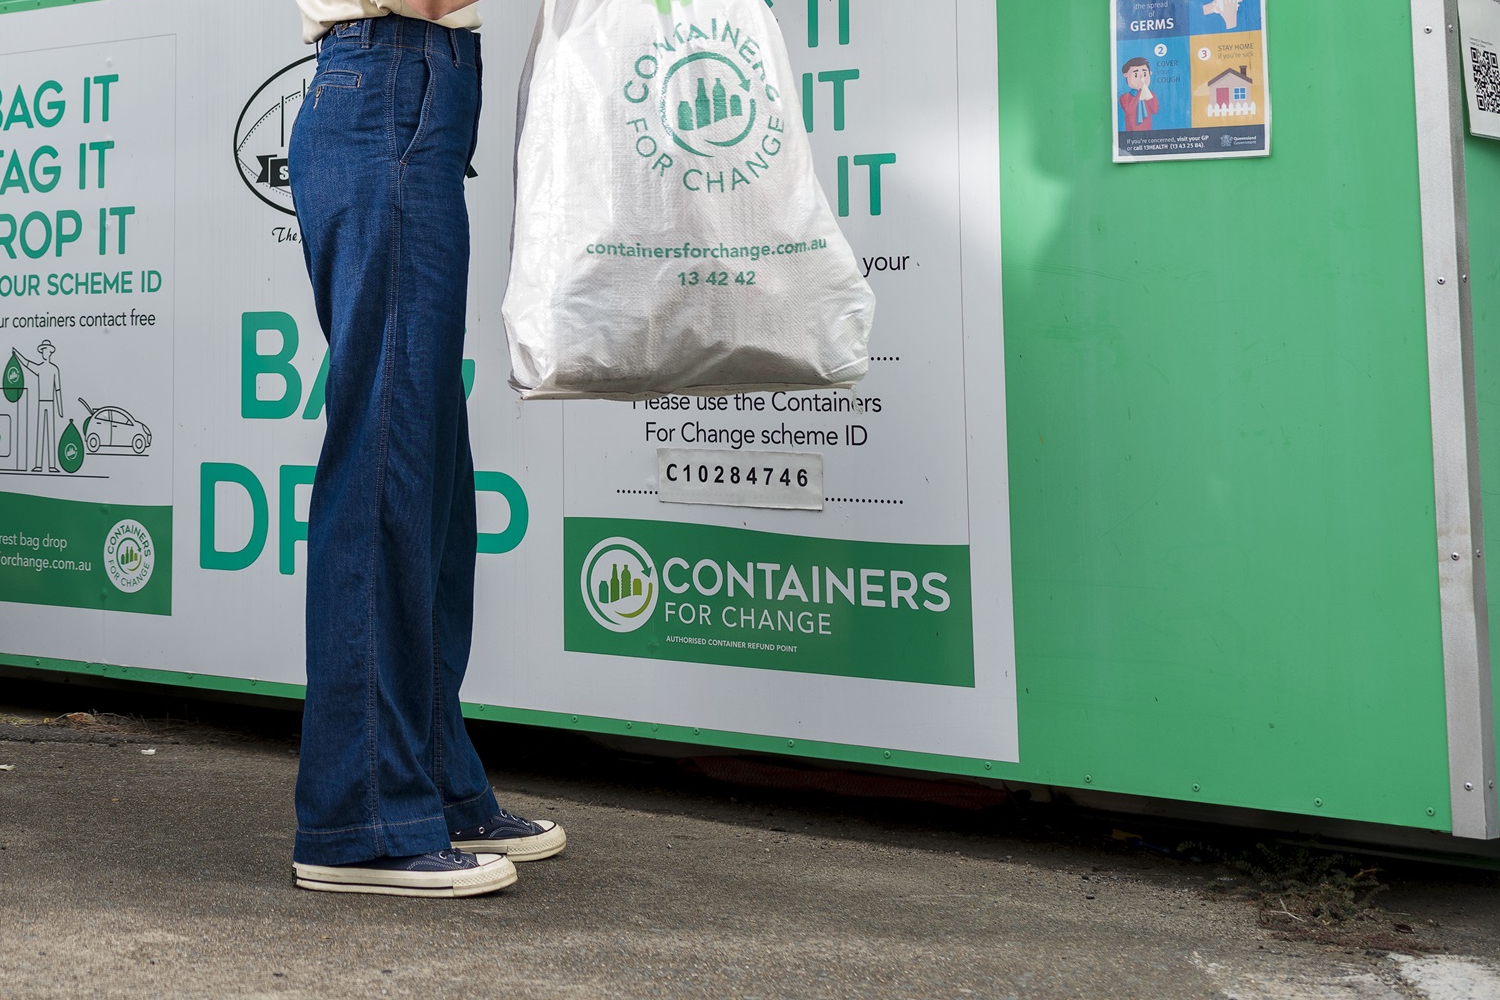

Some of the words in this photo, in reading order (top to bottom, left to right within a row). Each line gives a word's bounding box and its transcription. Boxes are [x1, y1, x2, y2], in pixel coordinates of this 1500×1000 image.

[1135, 1, 1145, 10] the
[1147, 1, 1168, 11] spread
[1130, 18, 1174, 32] GERMS
[1157, 46, 1164, 55] 2
[1201, 50, 1207, 58] 3
[1235, 43, 1254, 51] HOME
[83, 73, 119, 124] IT
[802, 68, 859, 133] IT
[79, 140, 115, 190] IT
[626, 118, 673, 177] FOR
[682, 115, 784, 193] CHANGE
[837, 152, 896, 217] IT
[99, 205, 135, 255] IT
[586, 237, 827, 261] containersforchange.com.au
[677, 271, 699, 286] 13
[706, 271, 729, 286] 42
[734, 270, 756, 286] 42
[862, 254, 910, 278] your
[47, 271, 133, 296] SCHEME
[141, 270, 162, 293] ID
[12, 312, 76, 329] containers
[79, 311, 127, 328] contact
[130, 308, 156, 326] free
[697, 395, 728, 411] use
[735, 392, 765, 411] the
[771, 391, 882, 413] Containers
[645, 421, 675, 442] For
[681, 421, 755, 449] Change
[761, 422, 838, 445] scheme
[845, 424, 868, 446] ID
[666, 463, 808, 487] C10284746
[20, 533, 40, 550] bag
[42, 534, 67, 551] drop
[107, 524, 151, 557] CONTAINERS
[107, 559, 120, 582] FOR
[120, 561, 150, 587] CHANGE
[662, 556, 951, 612] CONTAINERS
[664, 602, 711, 626] FOR
[721, 606, 832, 635] CHANGE
[666, 635, 706, 645] AUTHORISED
[708, 639, 746, 649] CONTAINER
[747, 643, 775, 651] REFUND
[776, 645, 797, 653] POINT
